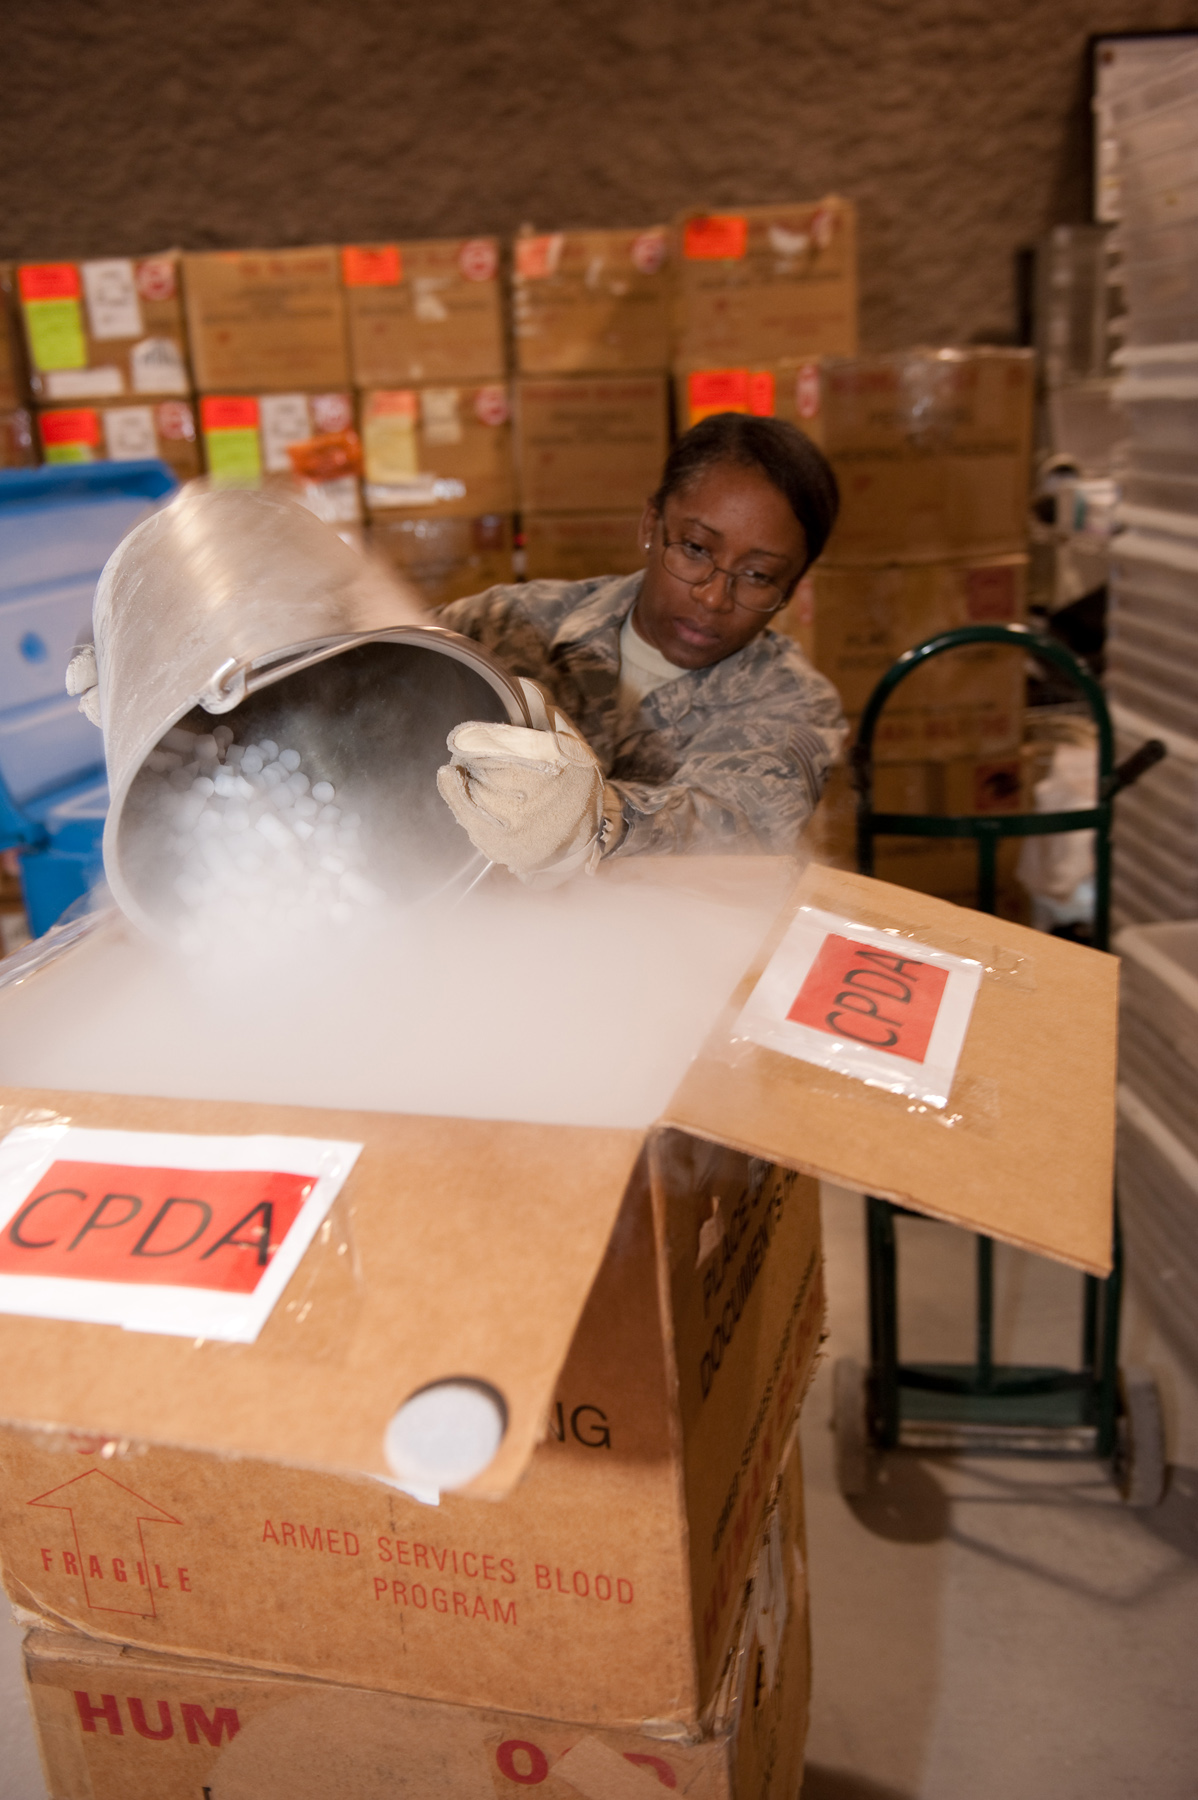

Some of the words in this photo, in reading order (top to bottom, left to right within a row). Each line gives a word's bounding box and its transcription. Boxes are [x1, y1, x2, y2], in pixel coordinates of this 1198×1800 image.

[824, 950, 924, 1047] CPDA
[8, 1188, 275, 1267] CPDA
[40, 1548, 193, 1593] FRAGILE
[262, 1519, 360, 1557] ARMED
[378, 1536, 517, 1584] SERVICES
[534, 1564, 635, 1605] BLOOD
[372, 1576, 518, 1626] PROGRAM
